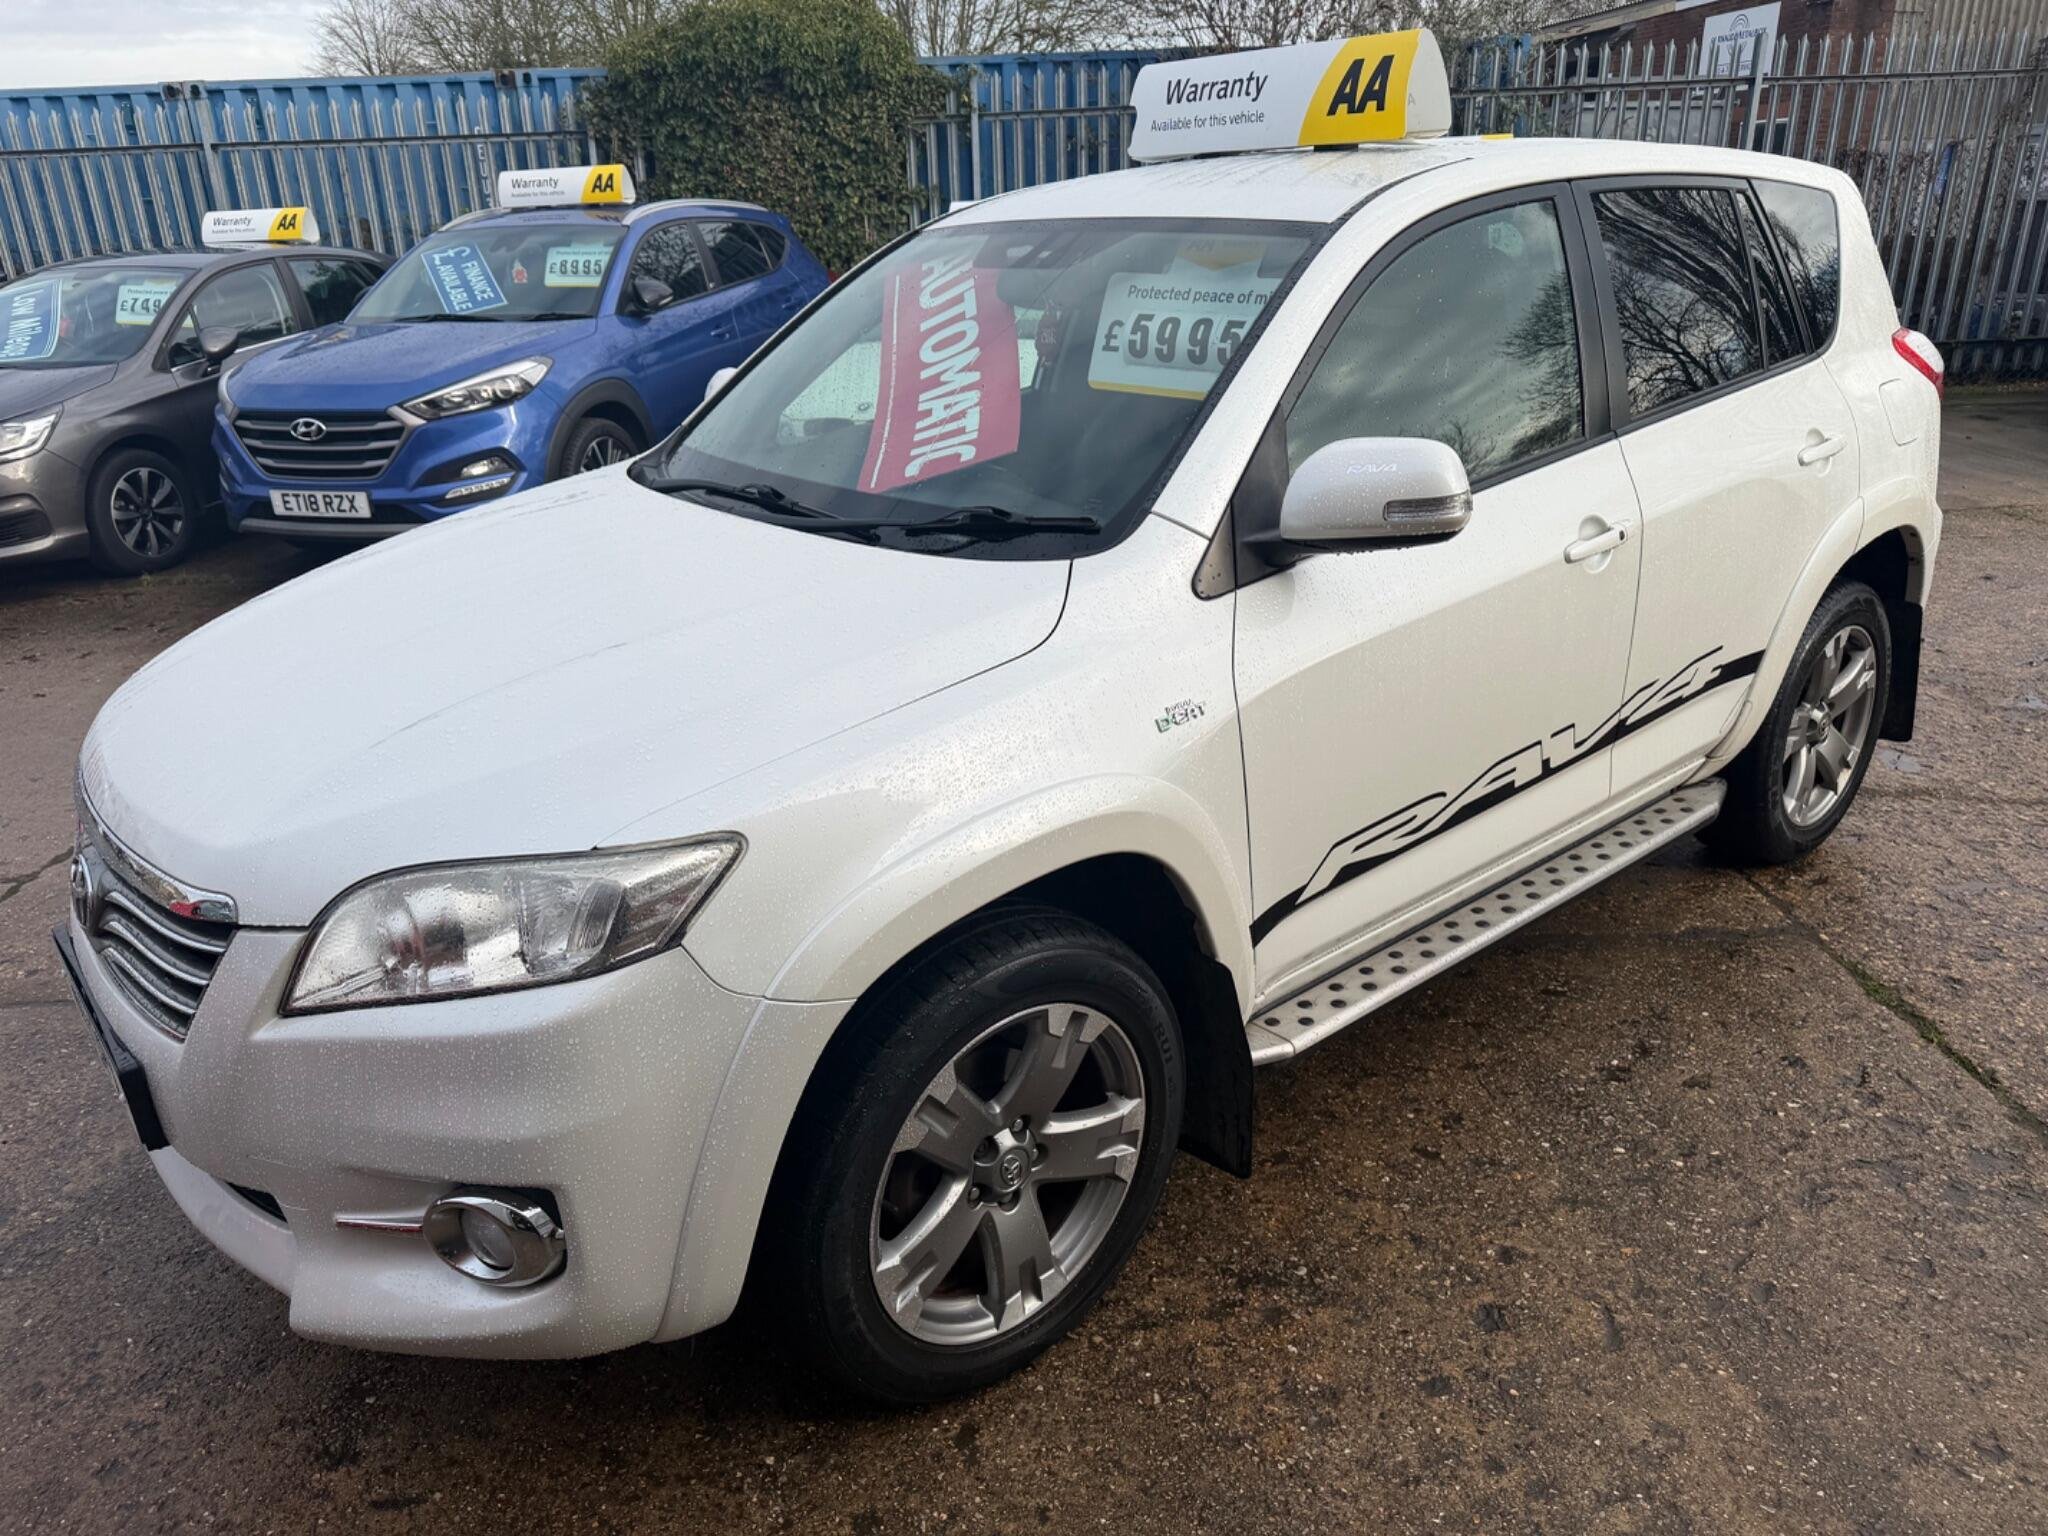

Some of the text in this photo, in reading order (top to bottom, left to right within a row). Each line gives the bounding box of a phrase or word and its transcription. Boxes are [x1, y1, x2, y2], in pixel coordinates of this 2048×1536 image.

[1166, 71, 1268, 105] Warranty
[1326, 54, 1395, 116] AA
[1151, 110, 1265, 132] Available for this vehicle
[511, 176, 560, 189] Warranty
[591, 173, 614, 193] AA
[213, 216, 253, 227] Warranty
[277, 213, 297, 231] AA
[436, 264, 472, 312] AVAILABLE
[461, 260, 494, 302] FINANCE
[1128, 284, 1192, 301] Protected
[1192, 290, 1235, 304] peace
[1237, 290, 1254, 304] of
[1102, 313, 1247, 367] £5995
[904, 255, 981, 478] AUTOMATIC
[1346, 463, 1398, 475] RAV4
[281, 493, 359, 513] ET18 RZX
